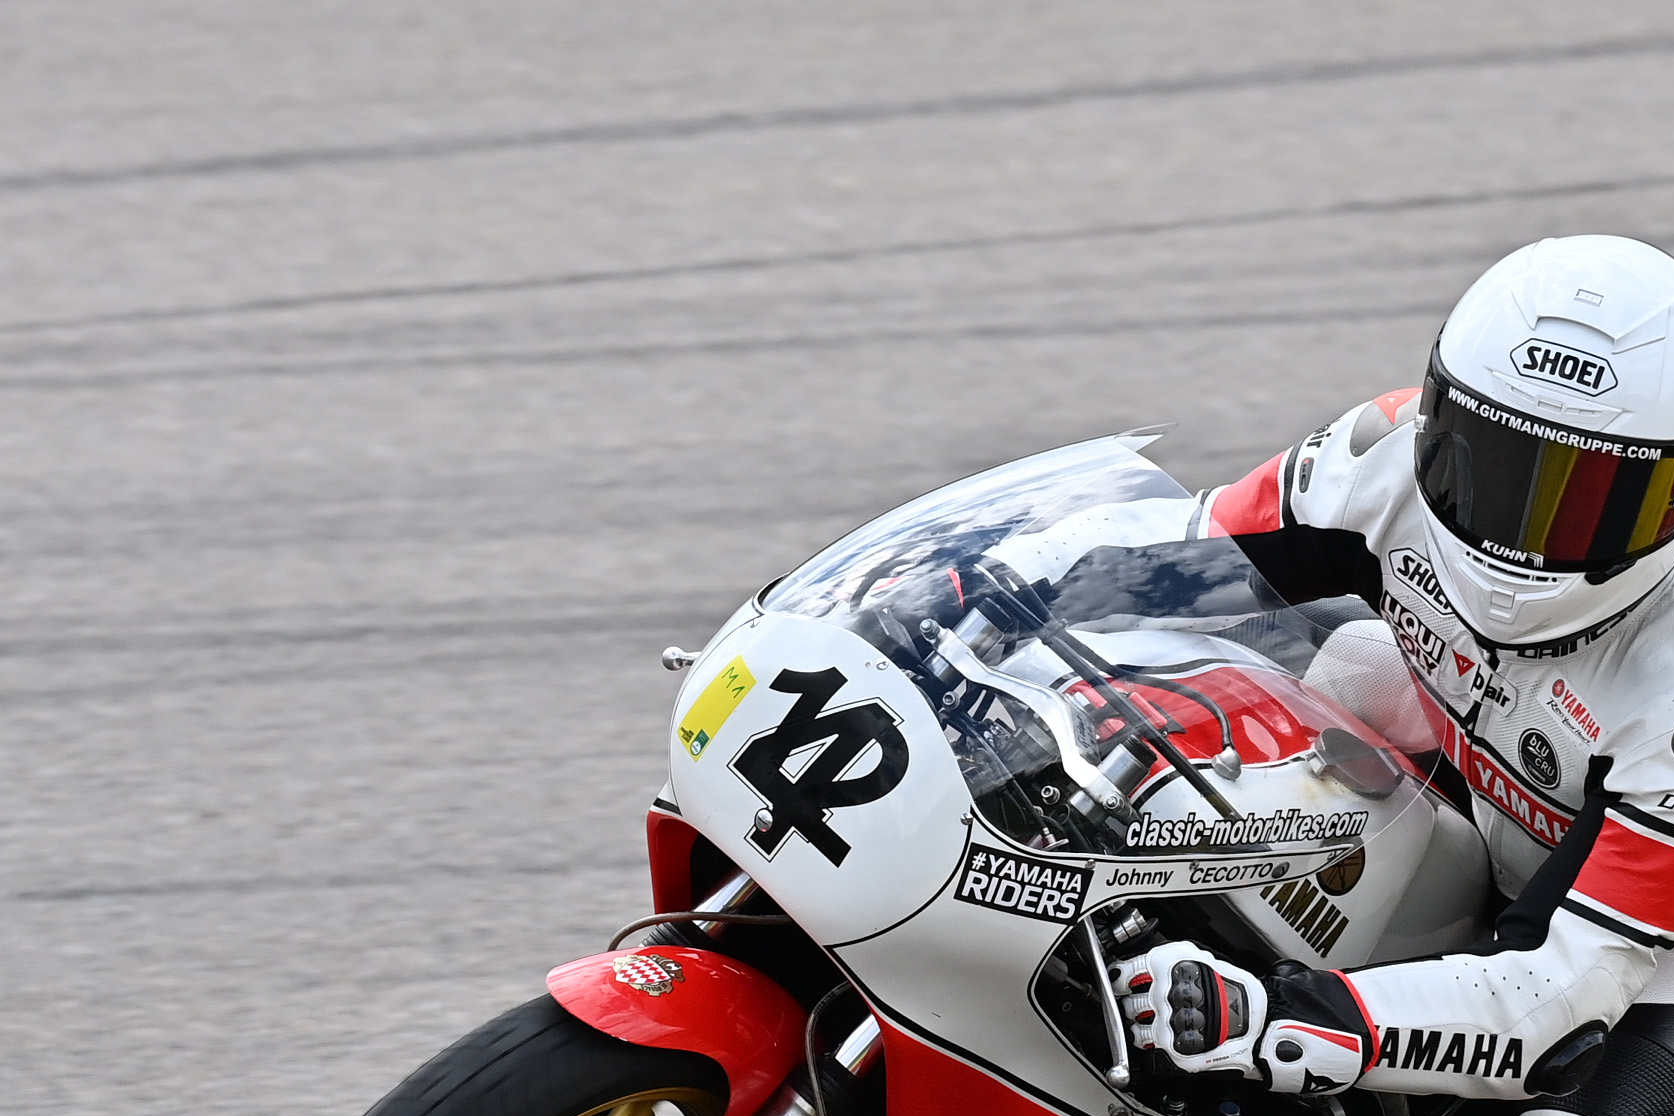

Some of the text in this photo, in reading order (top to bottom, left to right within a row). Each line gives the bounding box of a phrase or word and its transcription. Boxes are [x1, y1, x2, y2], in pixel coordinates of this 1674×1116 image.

[1523, 346, 1605, 390] SHOEI
[1448, 386, 1662, 461] WWW.GUTMANNGRUPPE.COM
[1481, 539, 1529, 563] KUHN
[1385, 597, 1445, 663] LIQUI
[1560, 689, 1601, 743] YAMAHA
[1562, 717, 1576, 733] Your
[1575, 728, 1592, 746] Heart
[1475, 760, 1569, 843] YAMAH
[1126, 809, 1370, 848] classic-motorbikes.com
[960, 870, 1079, 920] RIDERS
[971, 852, 1082, 893] #YAMAHA
[1105, 862, 1273, 888] Johnny CECOTTO
[1375, 1025, 1523, 1079] AMAHA
